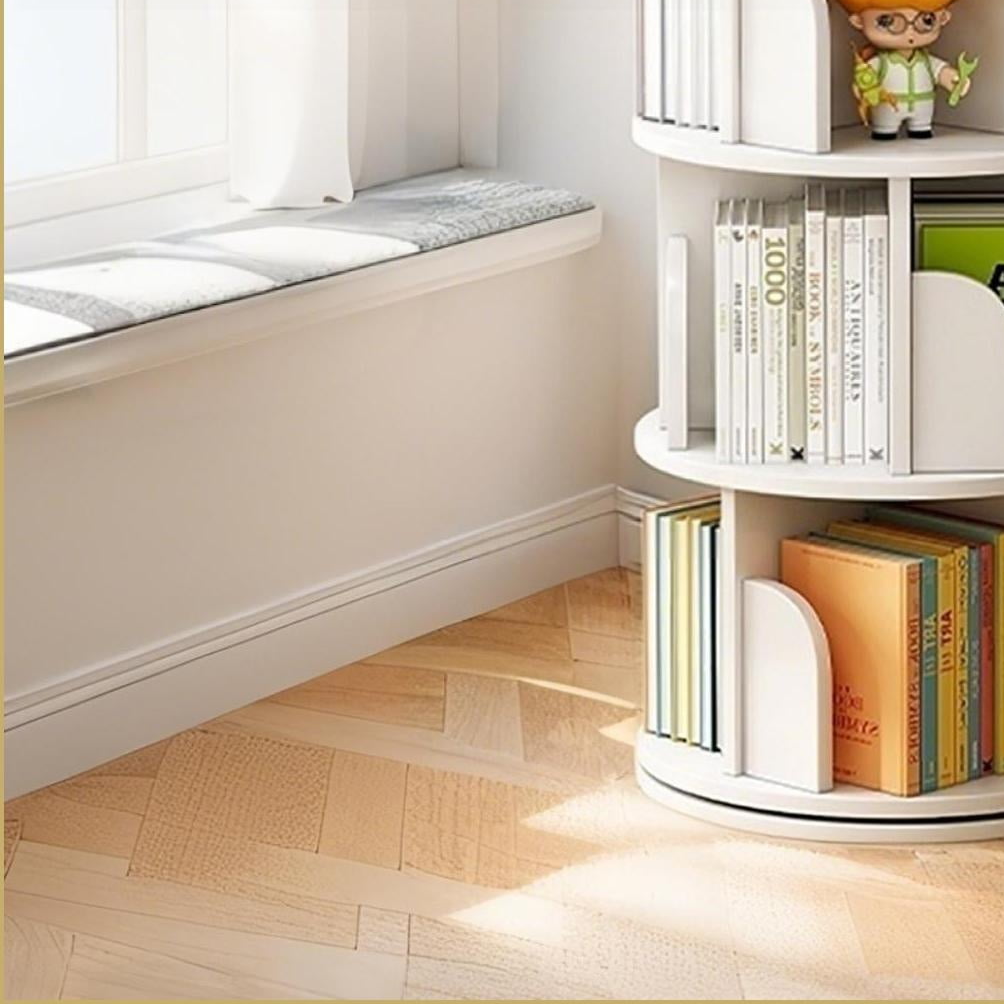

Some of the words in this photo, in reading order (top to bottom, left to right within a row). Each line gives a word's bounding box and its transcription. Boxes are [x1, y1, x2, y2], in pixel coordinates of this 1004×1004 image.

[765, 237, 785, 306] 1000
[808, 273, 821, 323] BOOK
[850, 280, 860, 402] ANTIQUAIRES
[809, 342, 821, 431] SYMBOLS
